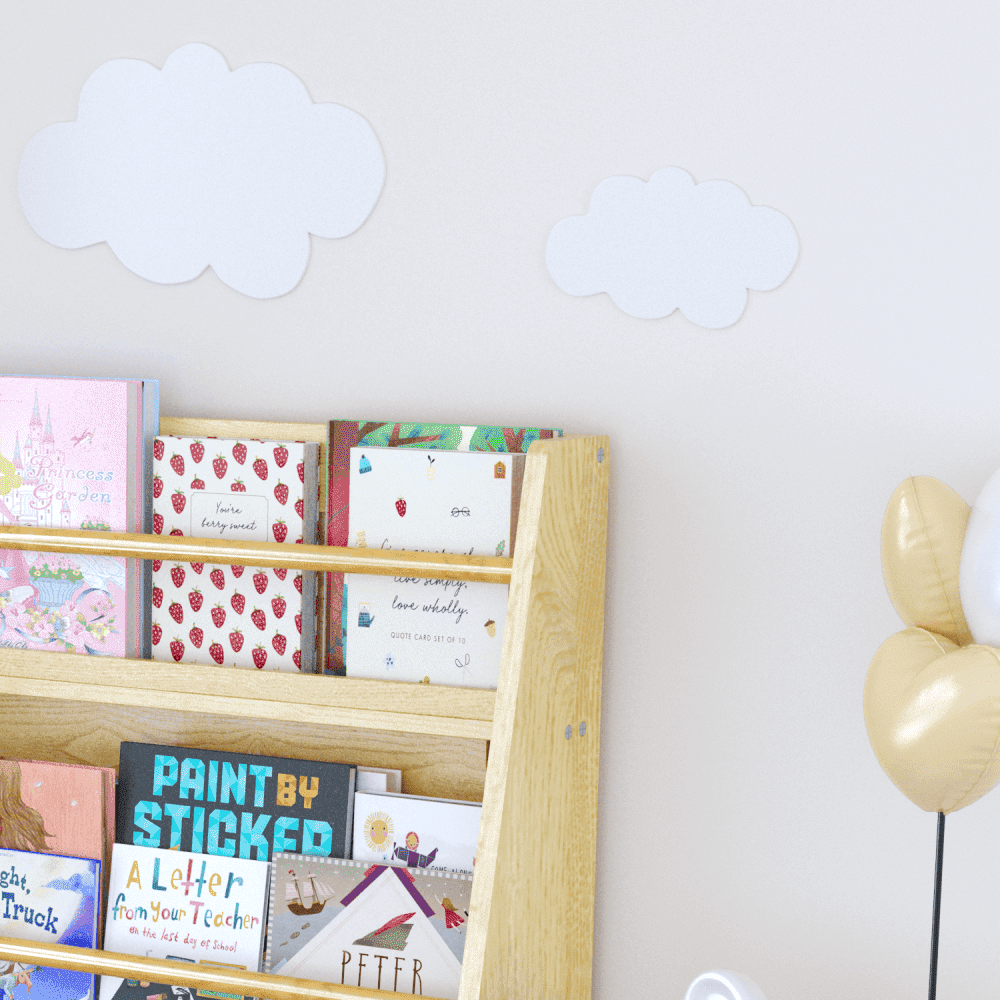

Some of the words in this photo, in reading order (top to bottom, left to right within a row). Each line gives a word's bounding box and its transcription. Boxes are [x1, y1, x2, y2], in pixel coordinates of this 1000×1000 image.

[27, 455, 114, 482] Princess
[29, 483, 112, 510] Garden
[201, 517, 228, 535] berry
[229, 520, 257, 531] sweet
[391, 595, 420, 611] love
[422, 598, 469, 625] wholly.
[390, 631, 412, 640] QUOTE
[413, 633, 432, 642] CARD
[433, 635, 444, 643] SET
[446, 636, 455, 644] OF
[458, 637, 467, 645] 10
[153, 754, 273, 808] PAINT
[276, 773, 320, 810] BY
[125, 860, 142, 890] A
[152, 857, 244, 899] Letter
[1, 891, 59, 934] Truck
[112, 893, 148, 921] from
[189, 900, 260, 930] Teacher
[129, 926, 140, 935] on
[142, 927, 157, 939] the
[160, 927, 179, 943] last
[183, 933, 198, 950] day
[200, 939, 211, 950] of
